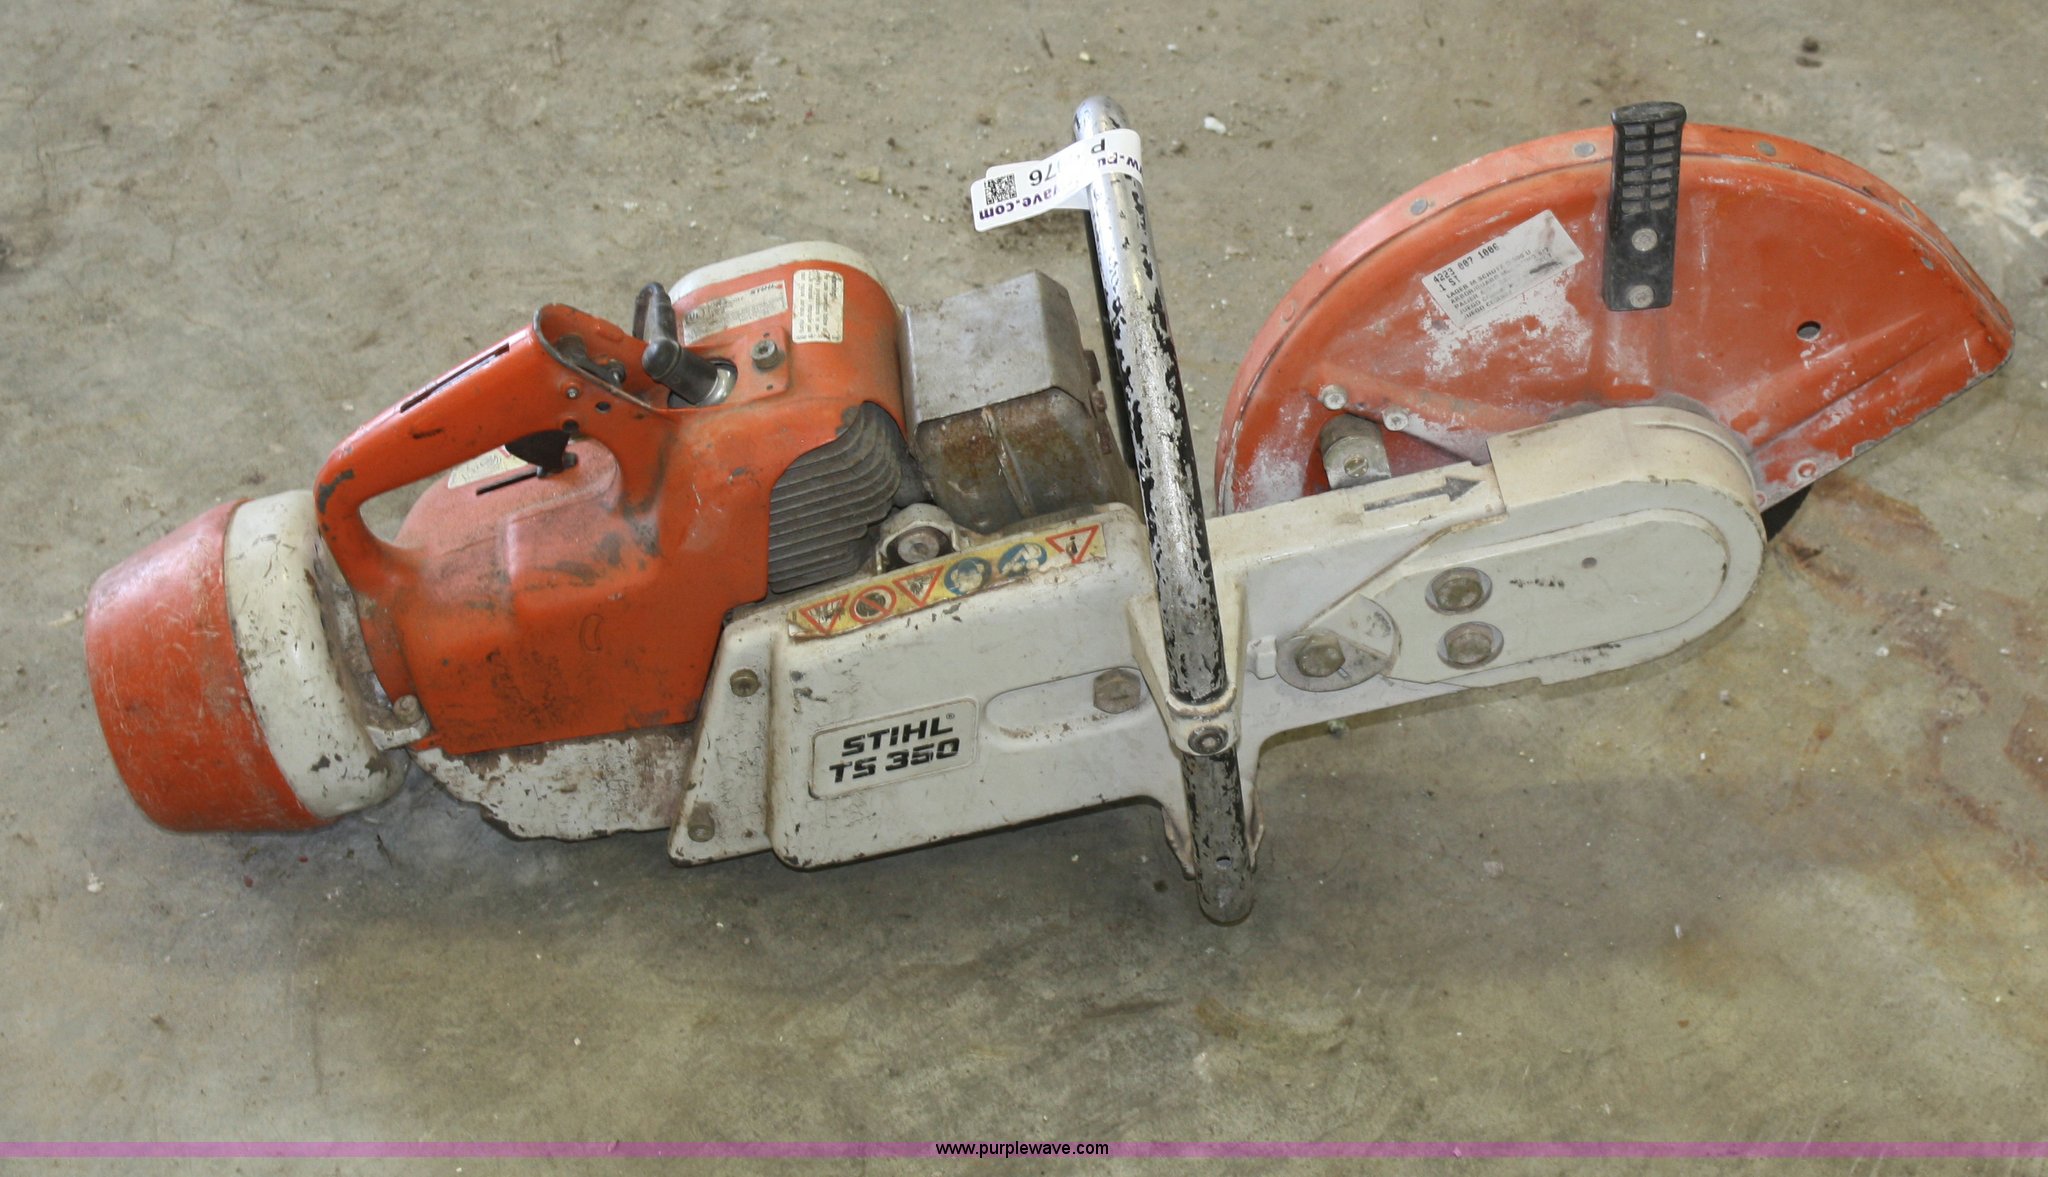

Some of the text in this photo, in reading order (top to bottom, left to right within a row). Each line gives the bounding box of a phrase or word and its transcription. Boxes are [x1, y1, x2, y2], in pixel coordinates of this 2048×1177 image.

[1433, 267, 1456, 283] 4223
[1458, 258, 1474, 271] 007
[841, 717, 953, 757] STIHL
[829, 737, 960, 783] TS 350
